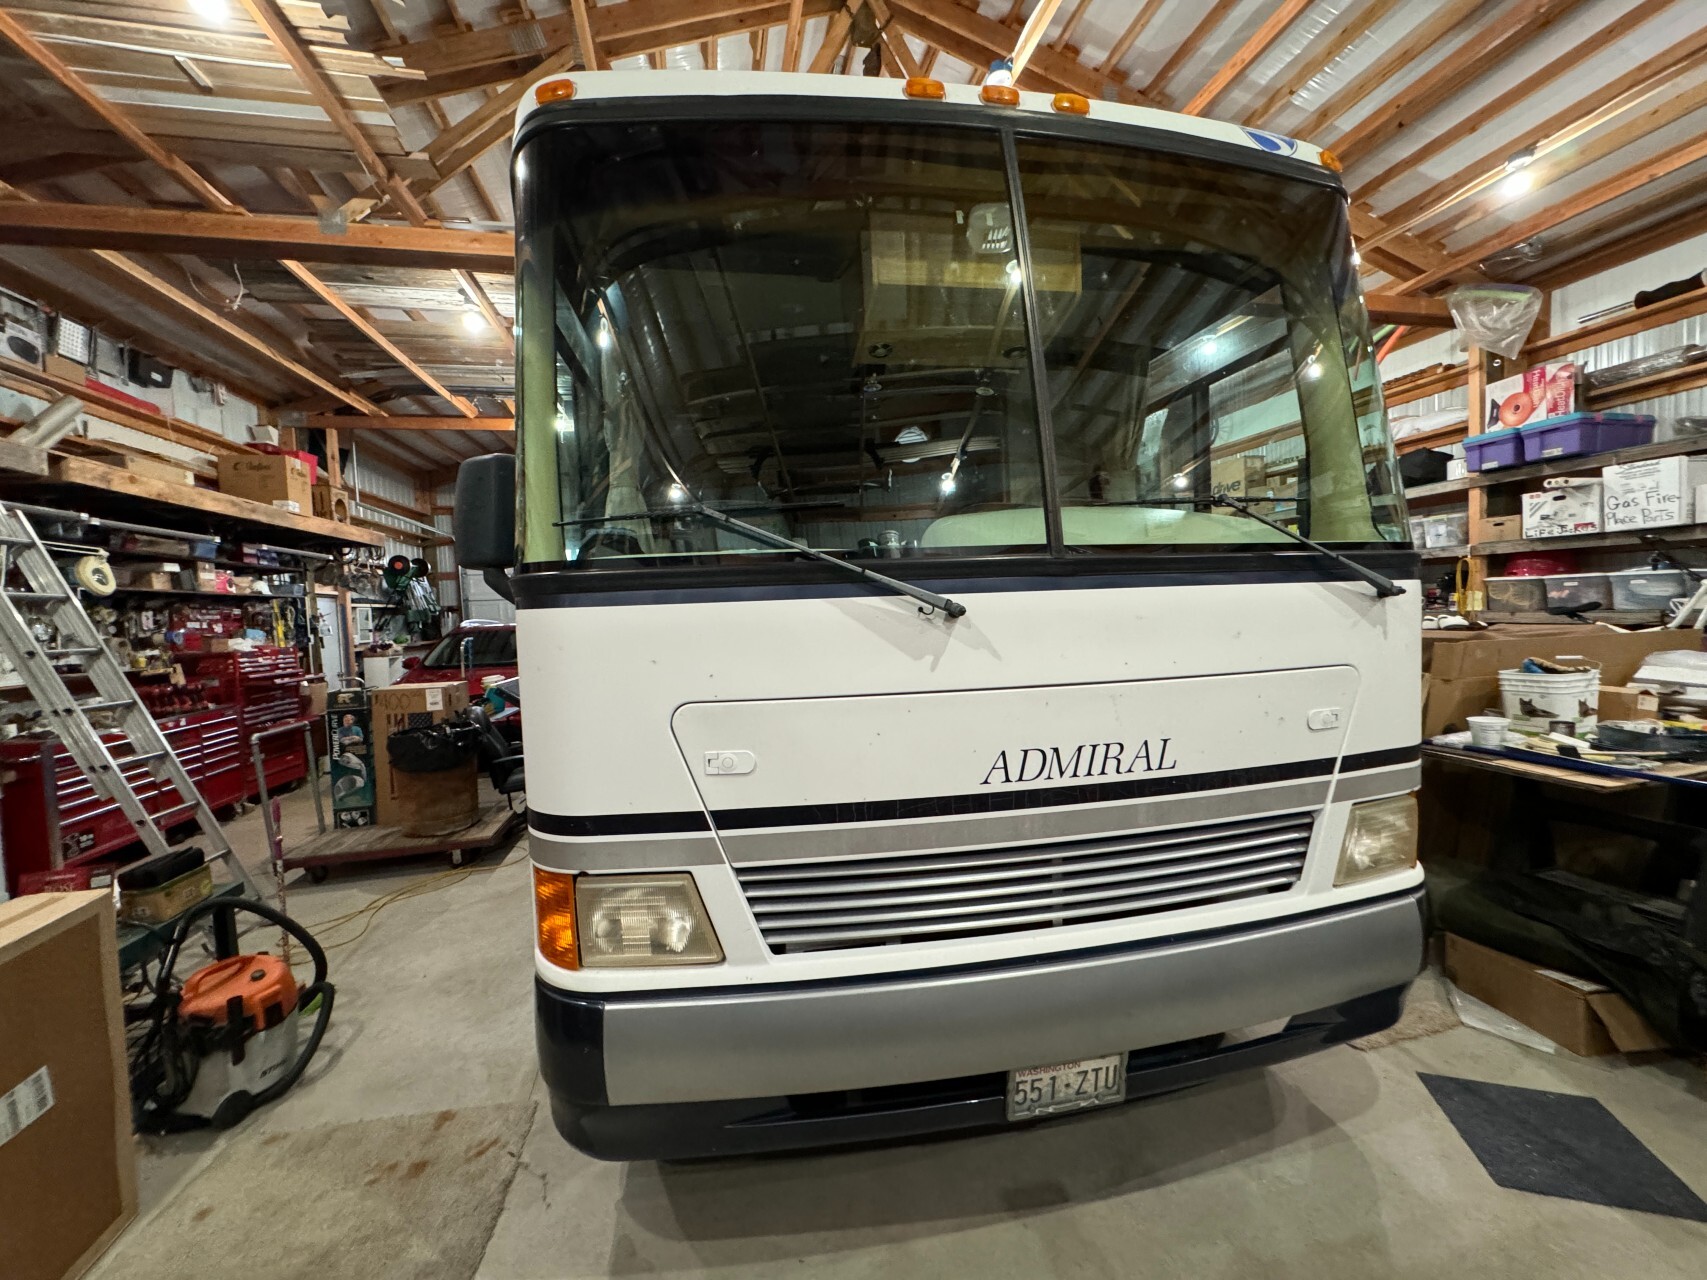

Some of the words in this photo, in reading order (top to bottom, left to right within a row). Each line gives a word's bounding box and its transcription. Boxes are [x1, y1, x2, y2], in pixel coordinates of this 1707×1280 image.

[1212, 480, 1241, 496] drive
[1606, 495, 1640, 511] Gas
[1606, 511, 1638, 526] Place
[980, 738, 1177, 785] ADMIRAL
[1017, 1062, 1081, 1078] WASHINGTON
